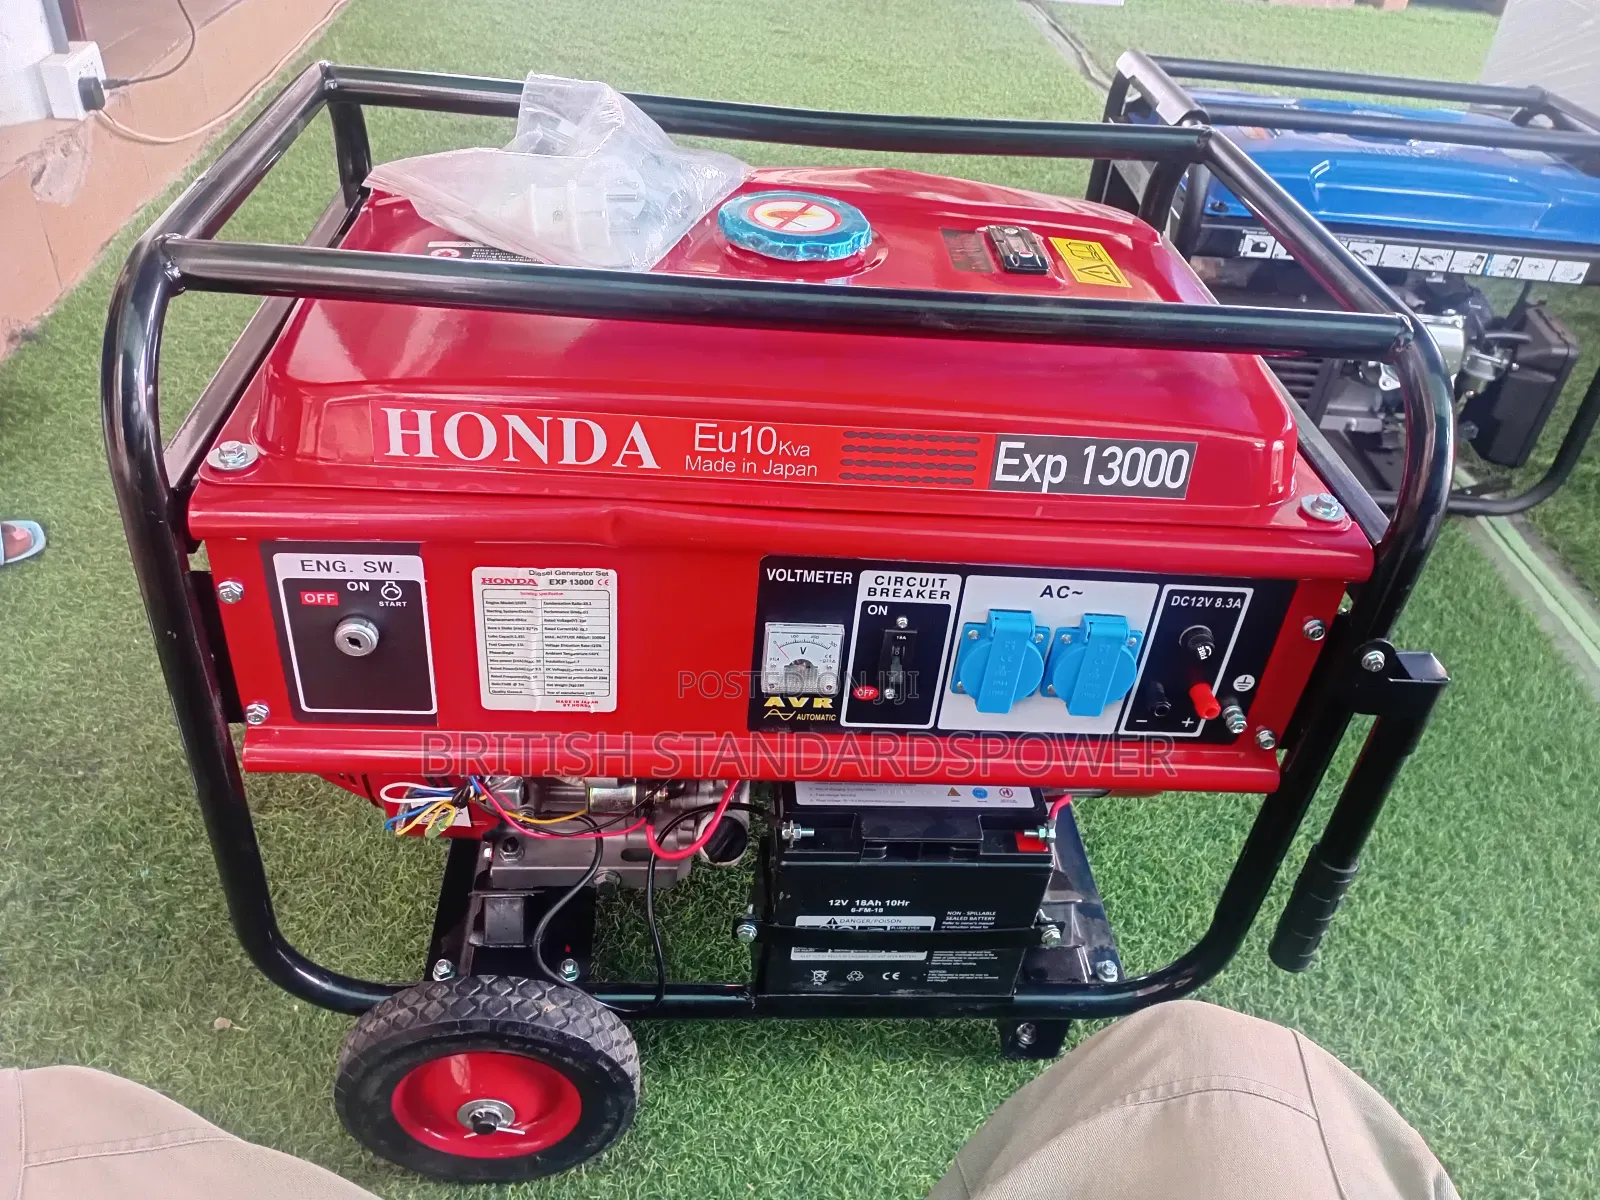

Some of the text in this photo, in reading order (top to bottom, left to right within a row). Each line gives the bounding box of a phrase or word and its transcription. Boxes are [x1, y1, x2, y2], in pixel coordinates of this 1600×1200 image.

[381, 408, 661, 469] HONDA
[685, 456, 818, 478] Made in Japan
[994, 441, 1189, 494] Exp 13000
[300, 560, 400, 574] ENG. SW.
[481, 578, 538, 586] HONDA
[766, 568, 853, 584] VOLTMETER
[874, 575, 948, 588] CIRCUIT
[346, 581, 370, 592] ON
[304, 594, 335, 604] OFF
[867, 587, 950, 600] BREAKER
[1171, 596, 1242, 609] DC12V 8.3A
[868, 604, 888, 616] ON
[1197, 645, 1208, 660] FUSE
[857, 689, 875, 697] OFF
[764, 696, 834, 708] AVR
[796, 713, 836, 721] AUTOMATIC
